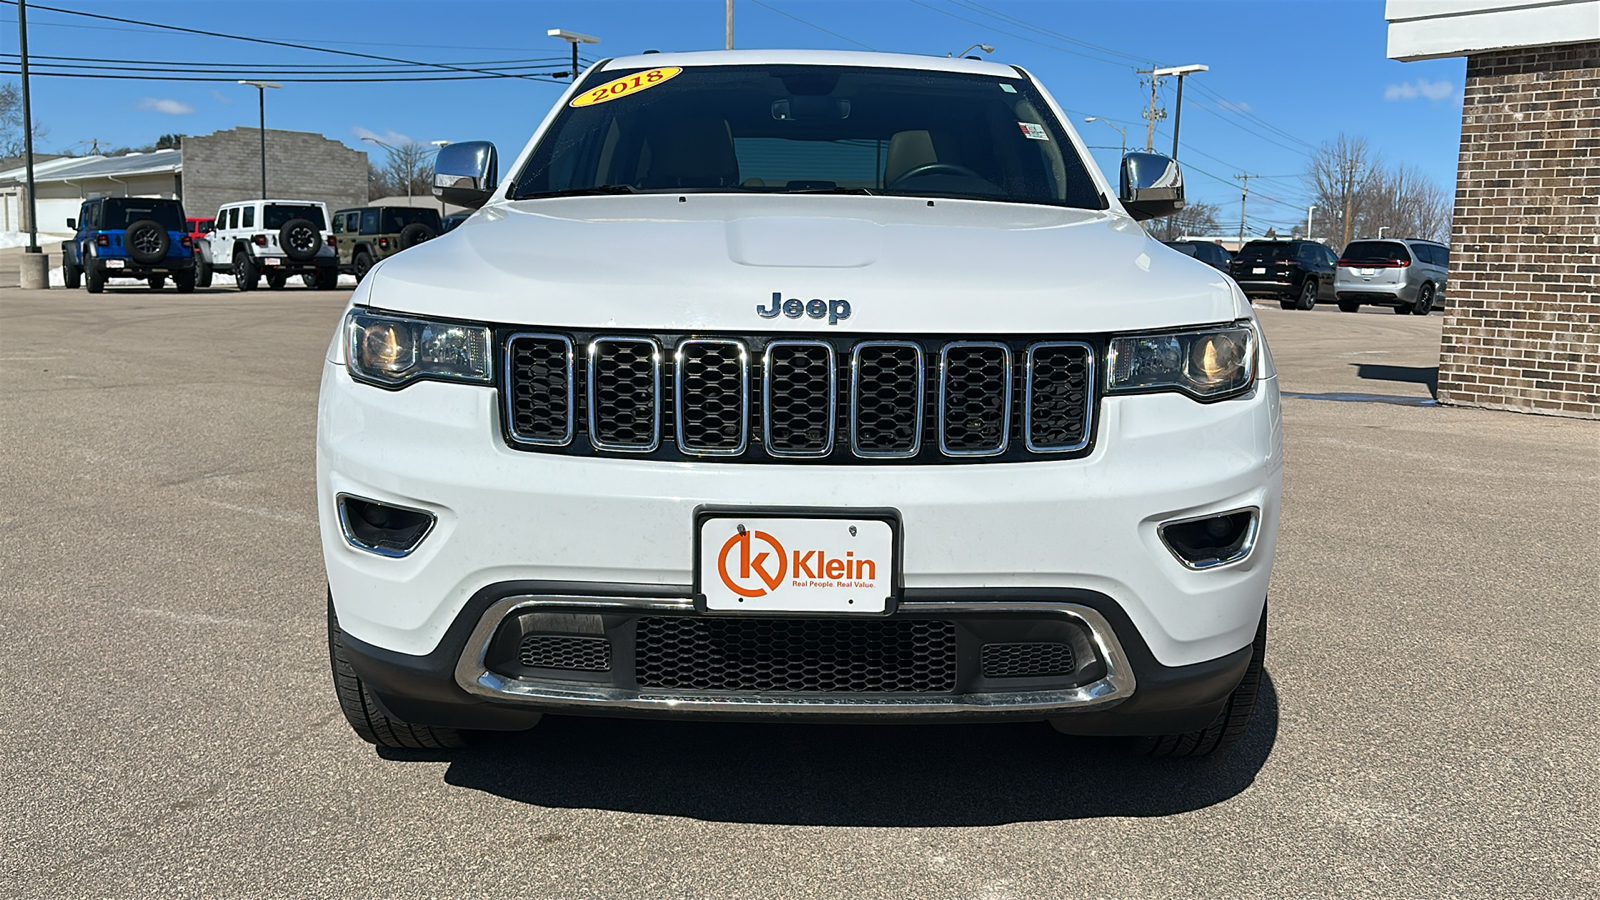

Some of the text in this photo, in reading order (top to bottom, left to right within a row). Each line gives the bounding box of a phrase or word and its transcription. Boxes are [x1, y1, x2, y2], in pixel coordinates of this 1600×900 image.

[592, 70, 664, 102] 2018
[756, 292, 852, 325] Jeep
[792, 550, 876, 580] Klein
[809, 580, 835, 588] People.
[854, 581, 876, 589] Value.
